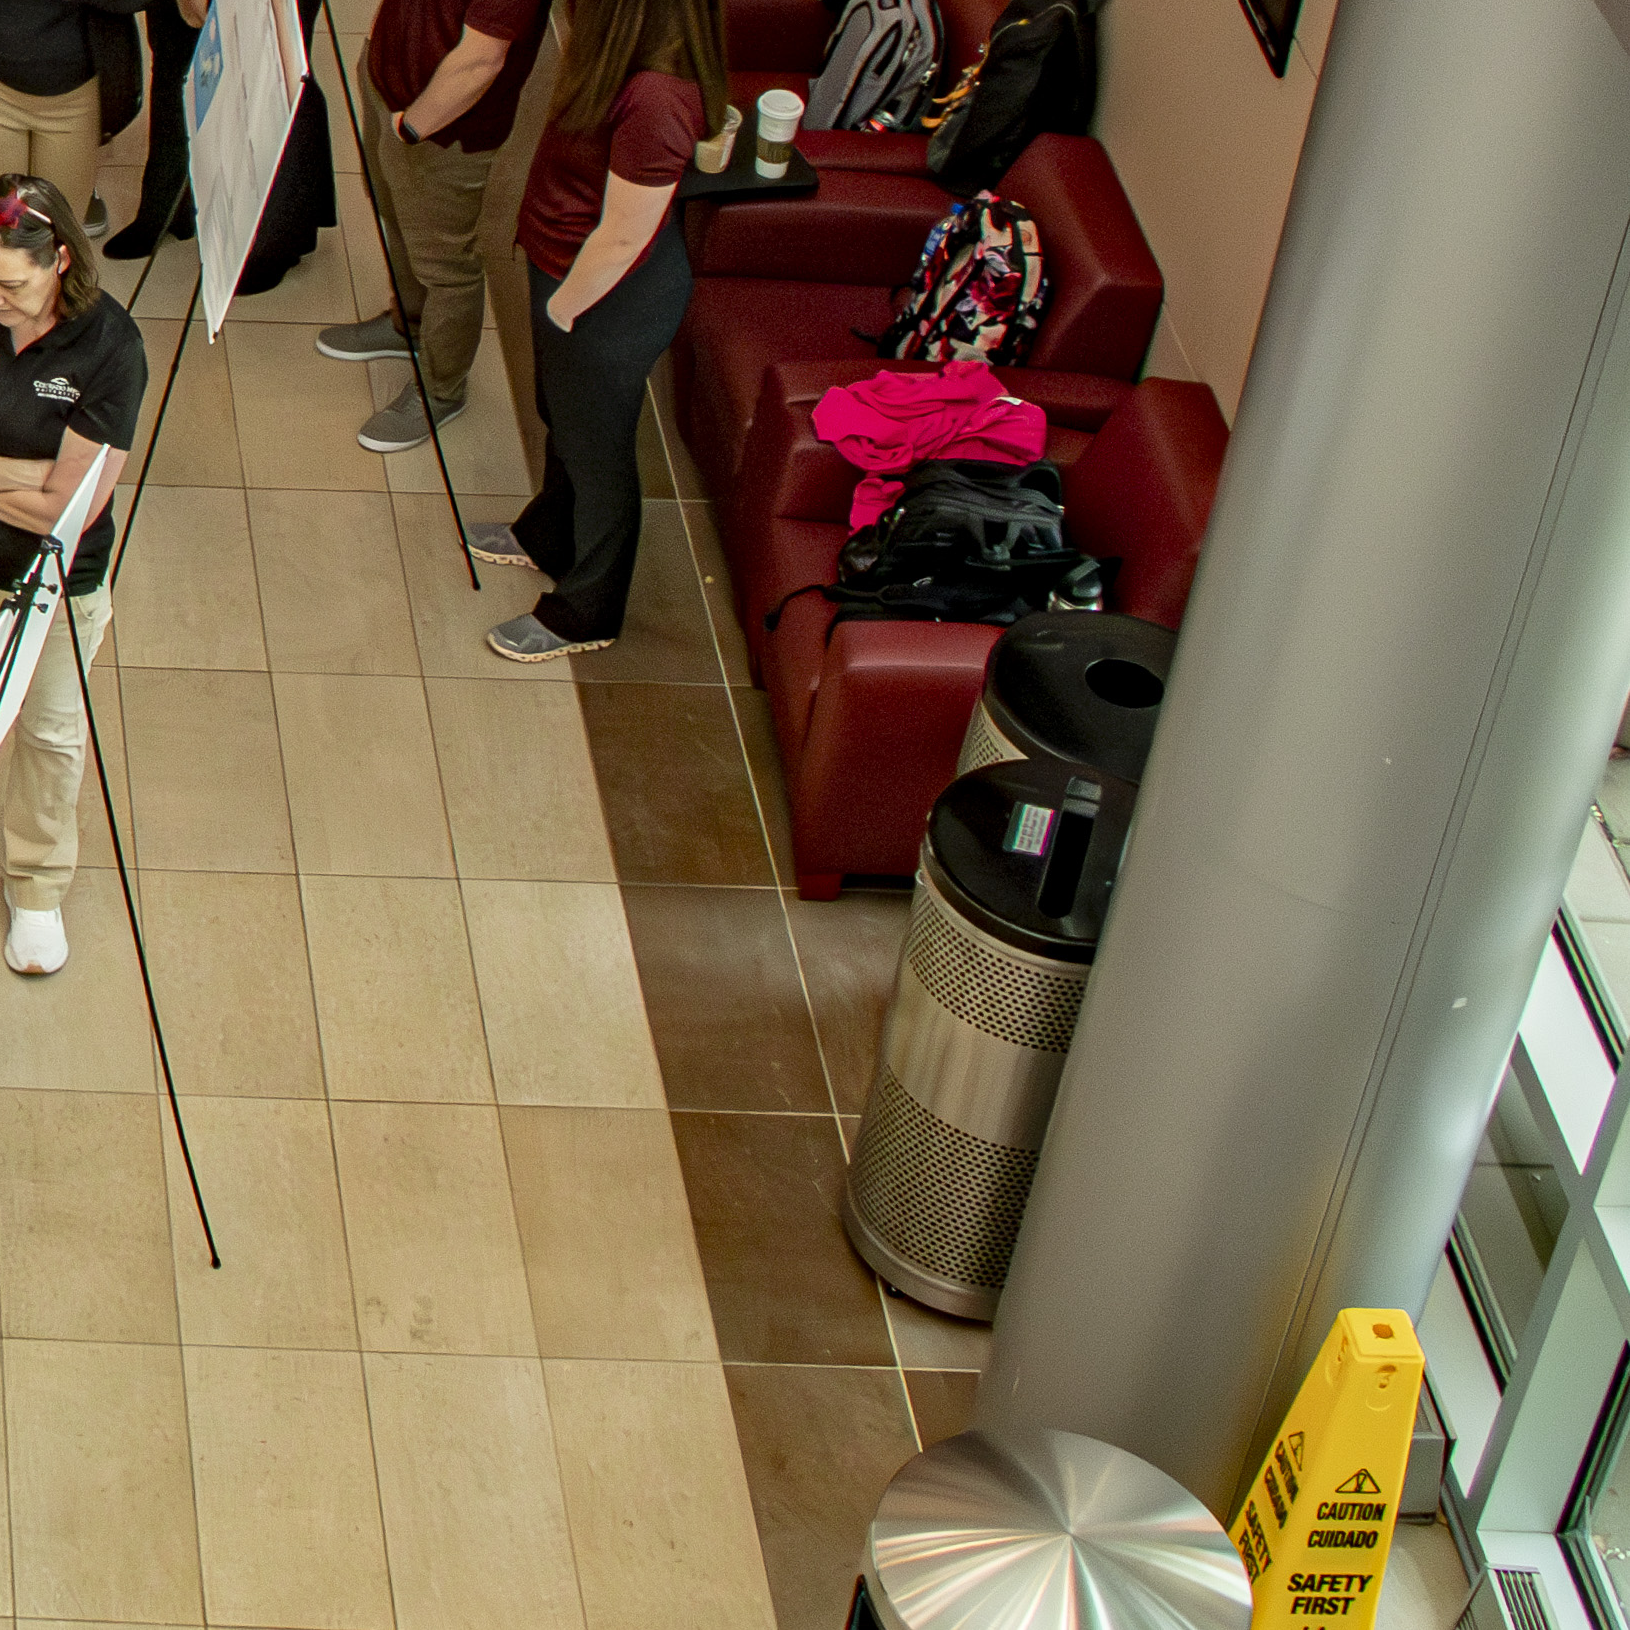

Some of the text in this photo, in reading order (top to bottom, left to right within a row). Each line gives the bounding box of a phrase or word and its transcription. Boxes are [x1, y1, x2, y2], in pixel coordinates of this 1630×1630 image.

[1316, 1501, 1388, 1521] CAUTION
[1307, 1529, 1380, 1549] CUIDADO
[1286, 1572, 1374, 1593] SAFETY
[1290, 1596, 1357, 1616] FIRST
